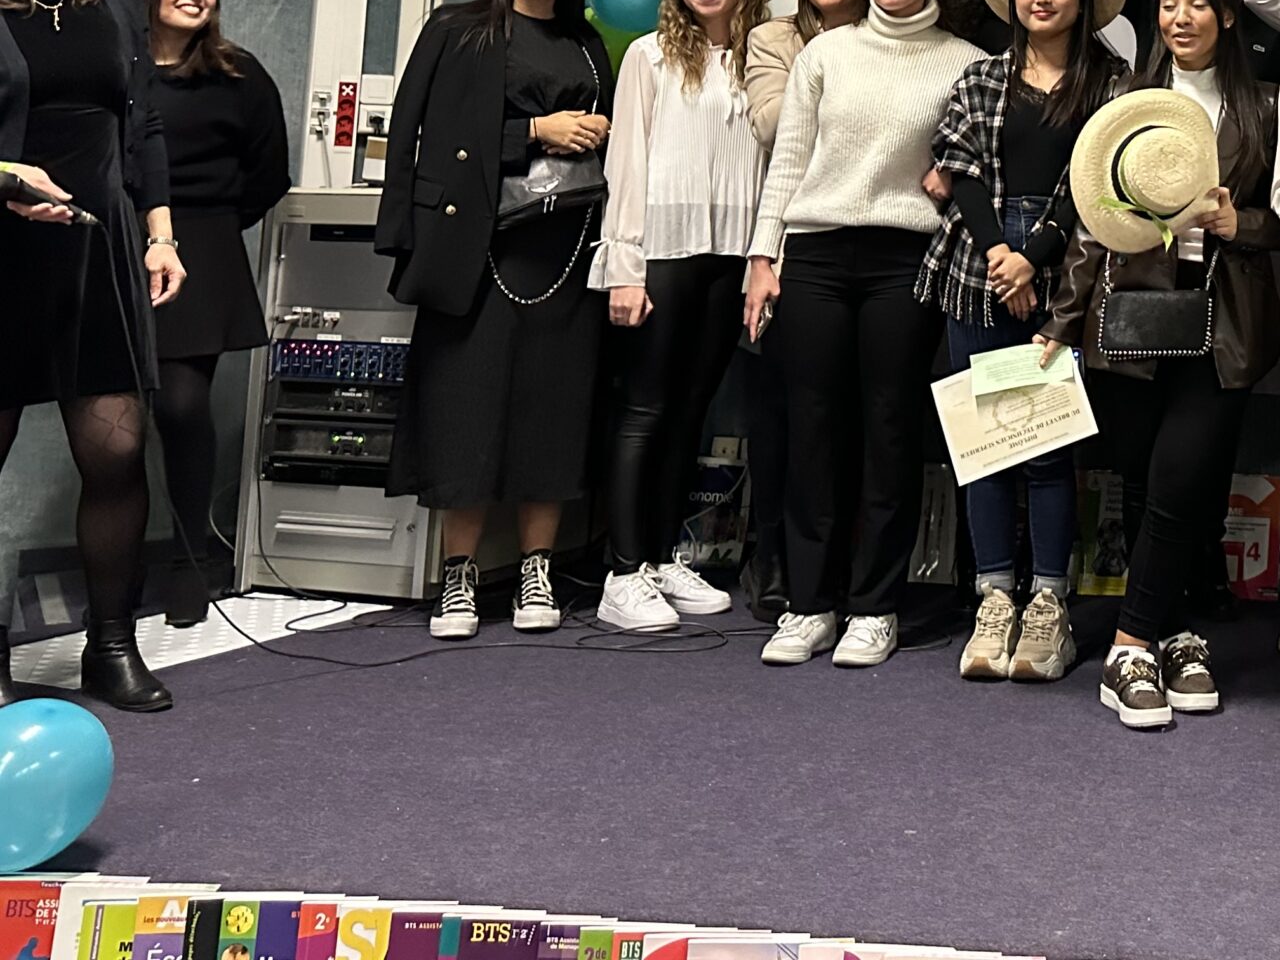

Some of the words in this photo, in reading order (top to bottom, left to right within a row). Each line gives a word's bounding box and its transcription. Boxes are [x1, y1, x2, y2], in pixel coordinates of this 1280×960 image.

[1246, 541, 1261, 561] 4
[6, 899, 36, 918] BTS
[36, 909, 49, 919] DE
[155, 916, 187, 924] nouveau
[470, 922, 511, 942] BTS
[621, 941, 641, 959] BTS
